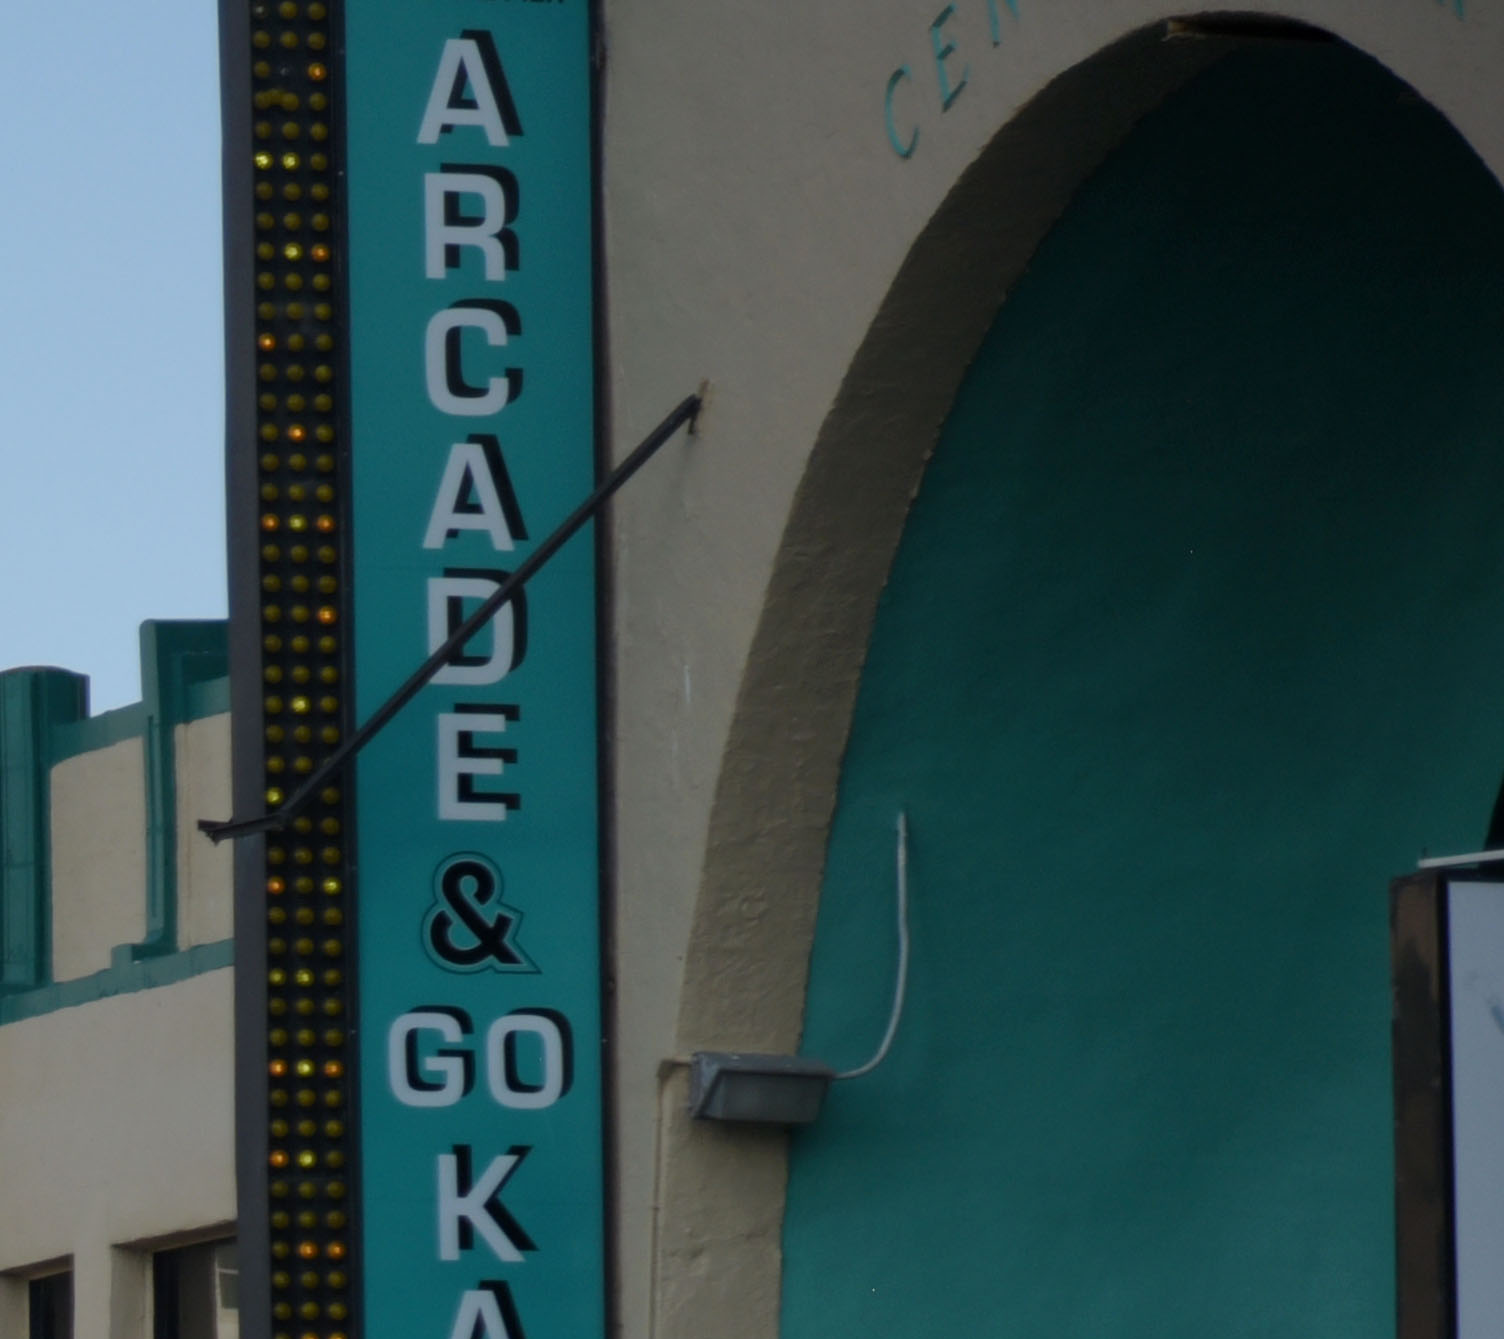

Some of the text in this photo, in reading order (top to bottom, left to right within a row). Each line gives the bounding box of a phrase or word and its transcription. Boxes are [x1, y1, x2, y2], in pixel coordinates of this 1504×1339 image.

[416, 29, 524, 822] ARCADE
[428, 858, 528, 970] &
[386, 1004, 575, 1110] GO
